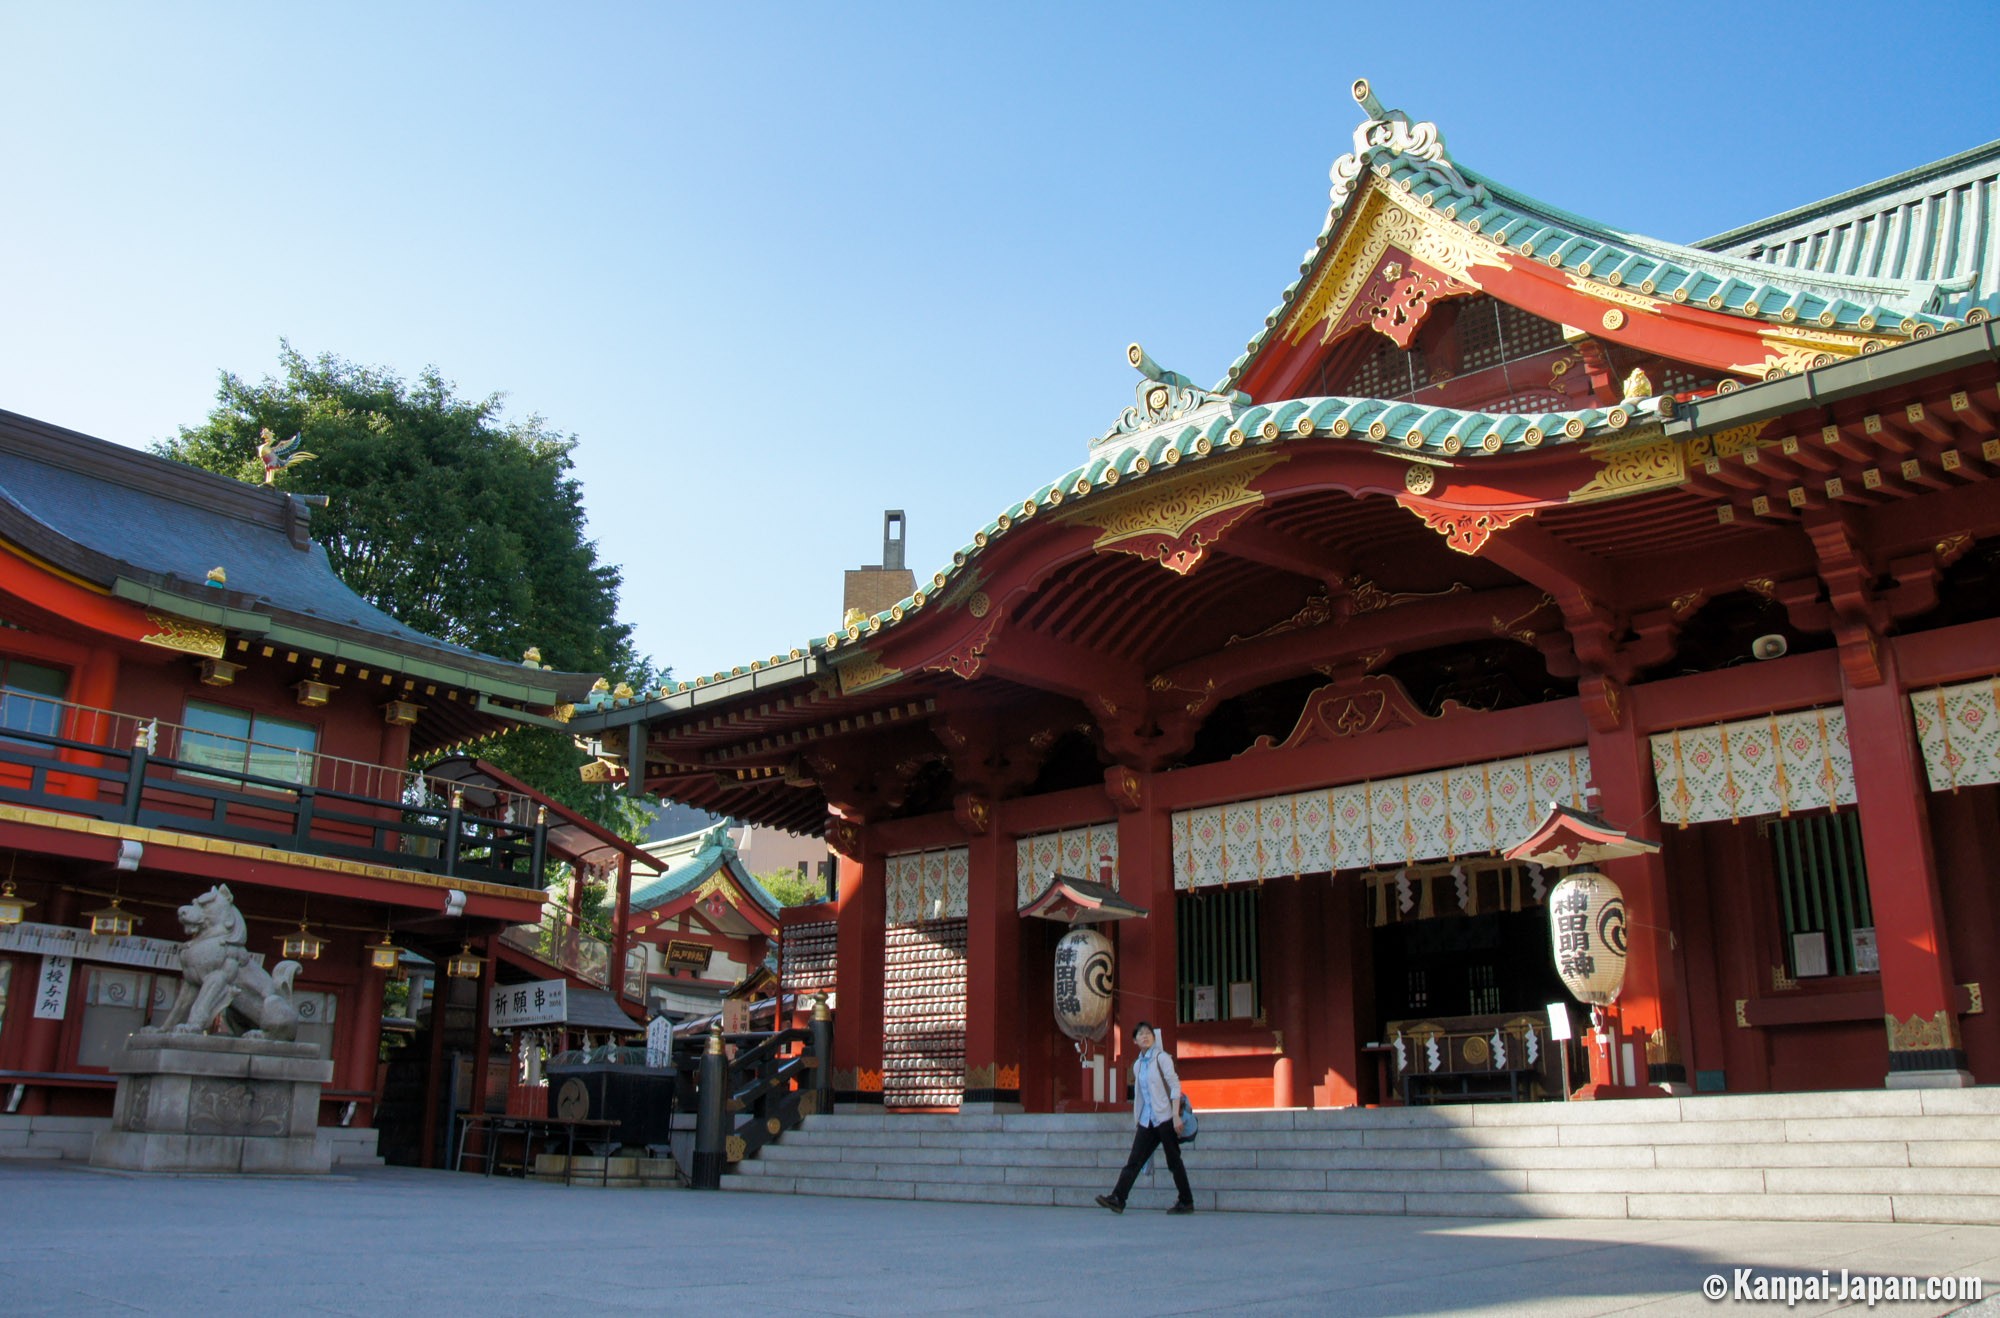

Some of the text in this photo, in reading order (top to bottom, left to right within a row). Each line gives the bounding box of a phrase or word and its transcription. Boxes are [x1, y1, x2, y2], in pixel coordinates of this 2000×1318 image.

[1555, 889, 1595, 979] 神田明神
[495, 987, 545, 1016] 祈願串
[1056, 946, 1081, 1016] 神田明神
